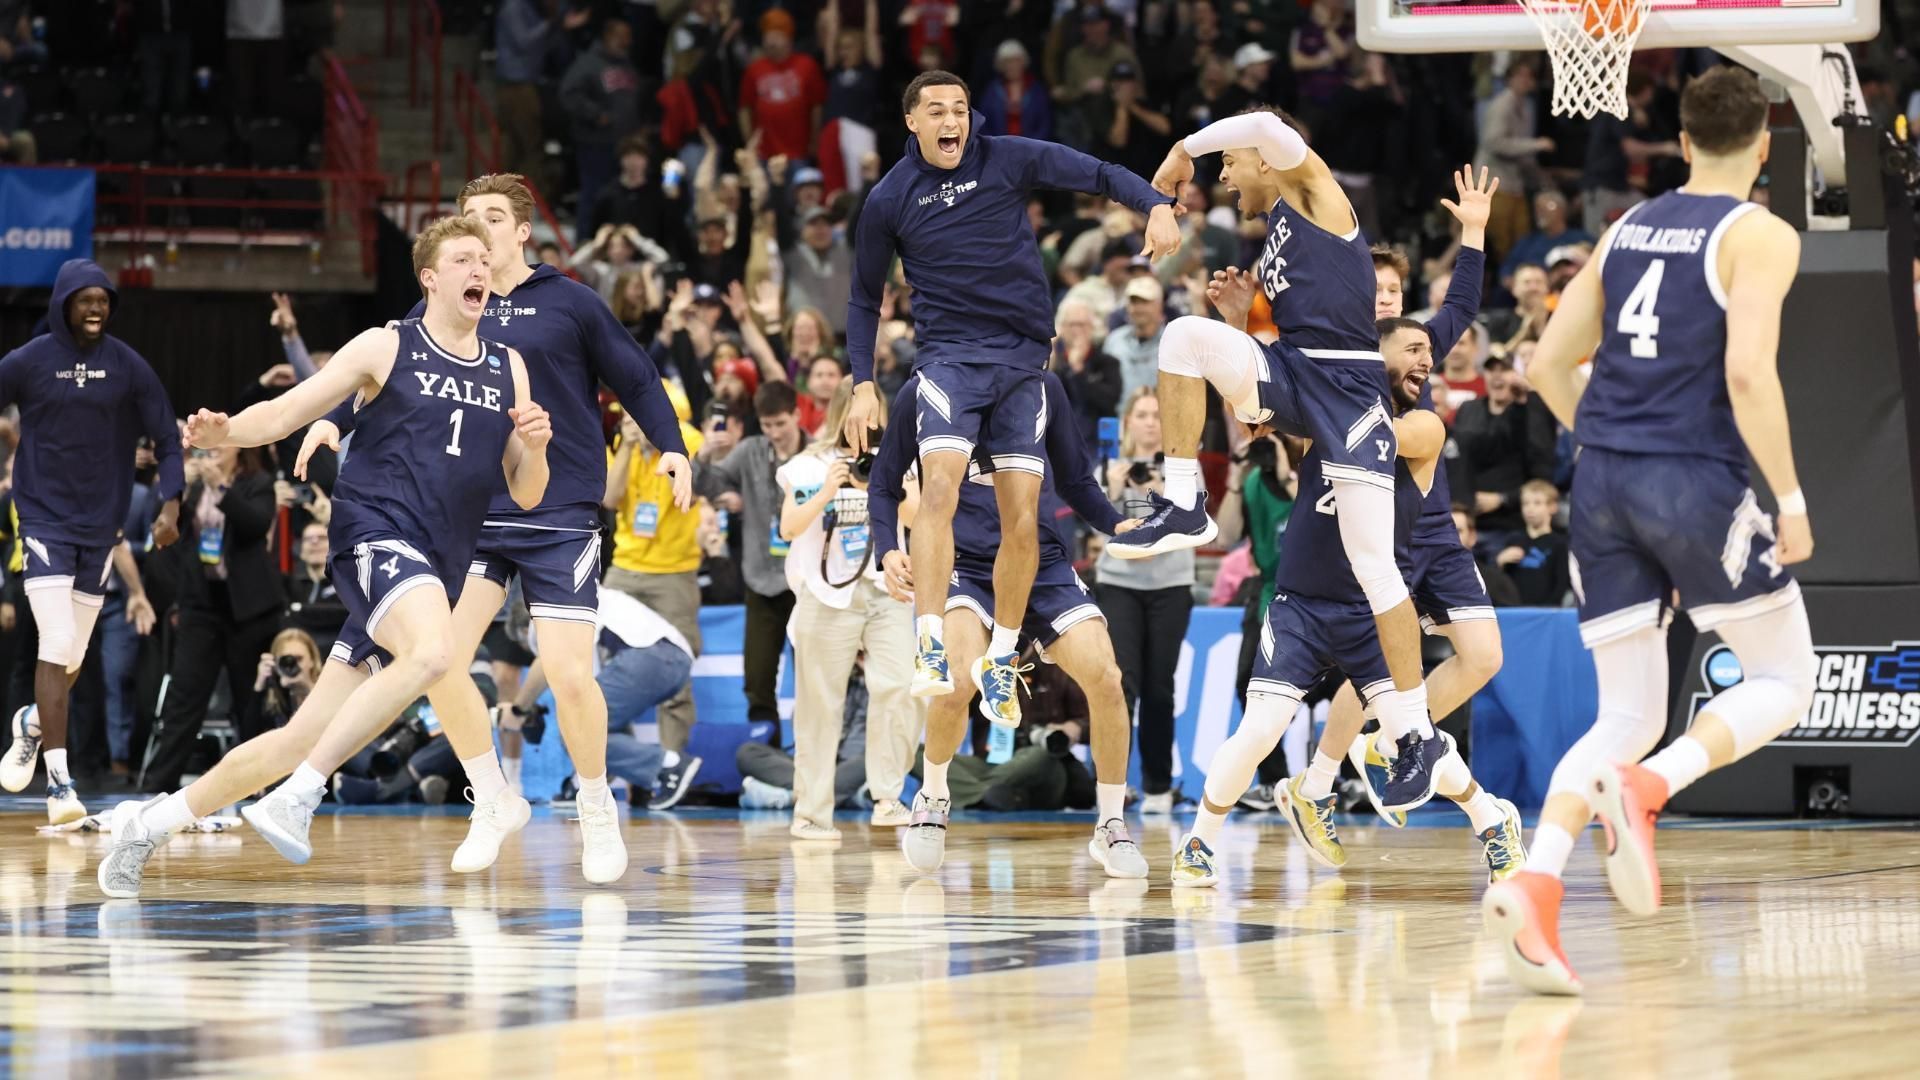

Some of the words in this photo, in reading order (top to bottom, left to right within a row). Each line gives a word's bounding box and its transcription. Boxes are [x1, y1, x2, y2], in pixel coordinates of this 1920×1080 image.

[918, 193, 939, 207] MADE
[939, 189, 955, 200] FOR
[954, 180, 978, 194] THIS
[943, 196, 955, 207] Y
[497, 307, 513, 317] FOR
[513, 307, 537, 316] THIS
[1617, 258, 1665, 359] 4
[499, 316, 511, 327] Y
[87, 369, 106, 379] THIS
[414, 371, 501, 413] YALE
[445, 408, 464, 457] 1
[1375, 439, 1390, 461] Y
[379, 554, 401, 580] Y
